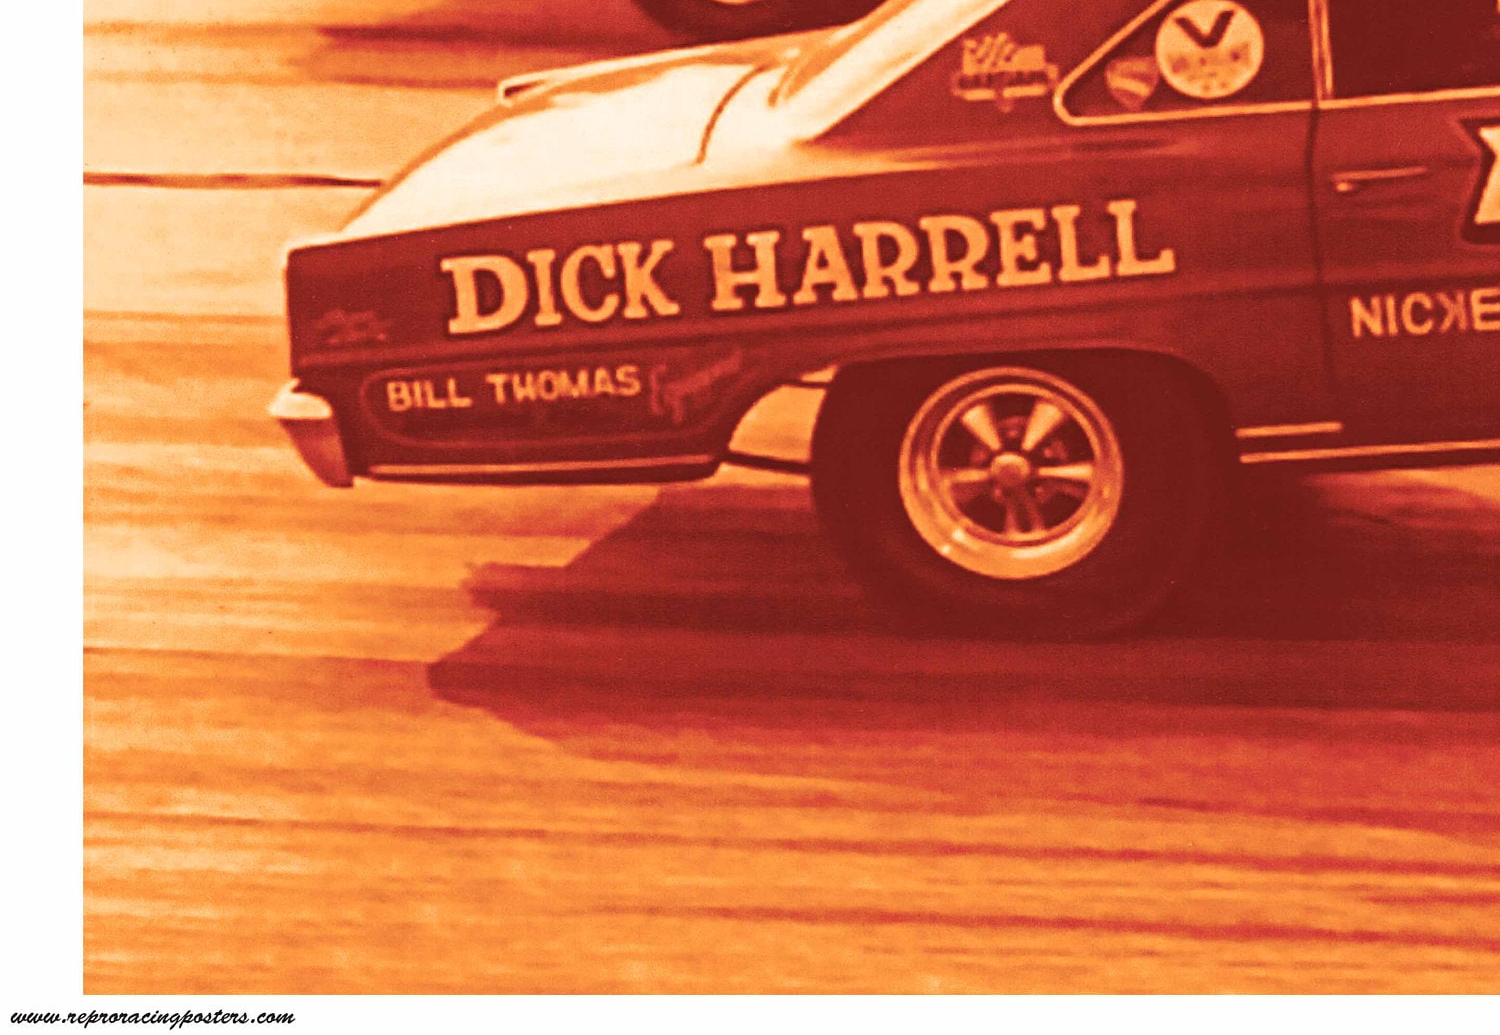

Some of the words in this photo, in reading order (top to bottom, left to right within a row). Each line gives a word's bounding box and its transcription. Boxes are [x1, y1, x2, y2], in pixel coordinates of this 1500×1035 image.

[440, 238, 681, 336] DICK
[702, 199, 1177, 311] HARRELL
[385, 377, 474, 413] BILL
[486, 364, 643, 406] THOMAS
